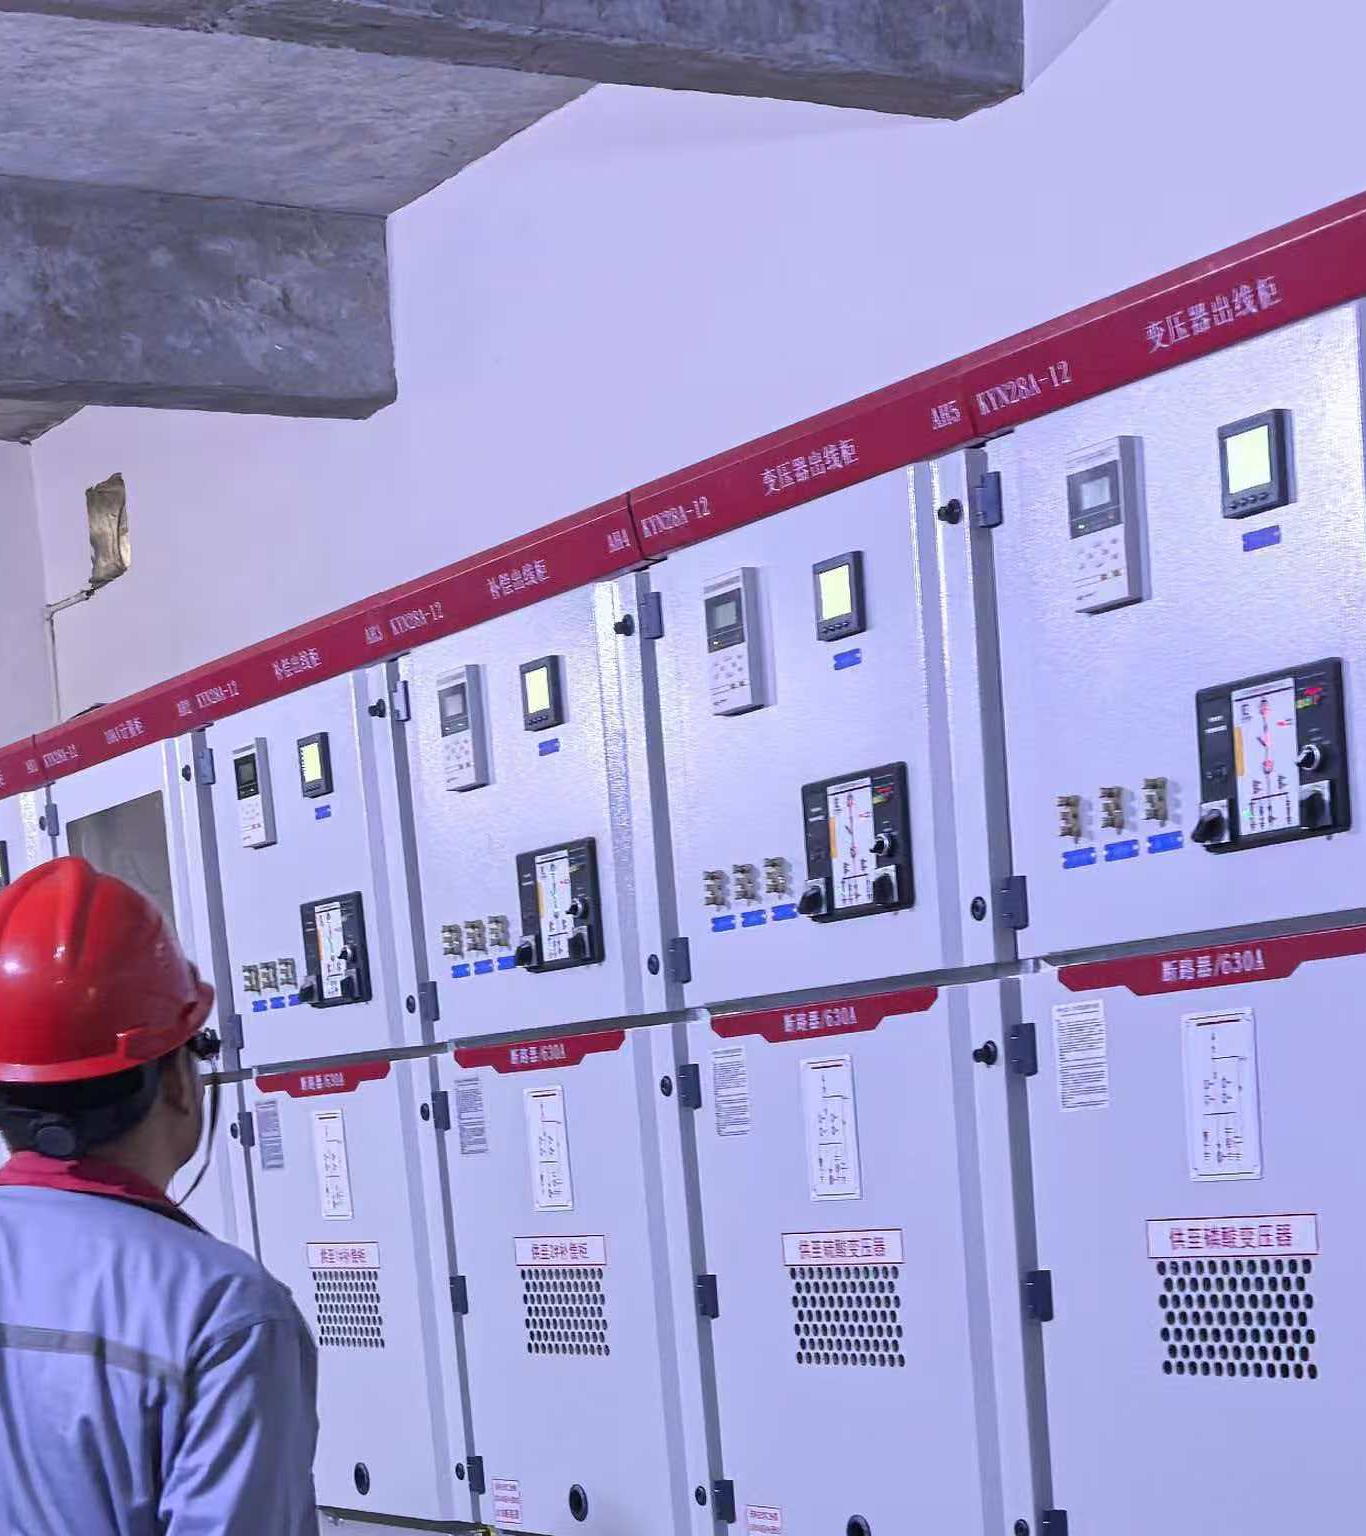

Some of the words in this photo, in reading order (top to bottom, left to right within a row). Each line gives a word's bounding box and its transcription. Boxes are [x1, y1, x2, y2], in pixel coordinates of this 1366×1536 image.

[1145, 276, 1283, 354] 变压器出线柜
[761, 438, 859, 496] 变压器出线柜
[1162, 948, 1267, 982] 断路器/630A
